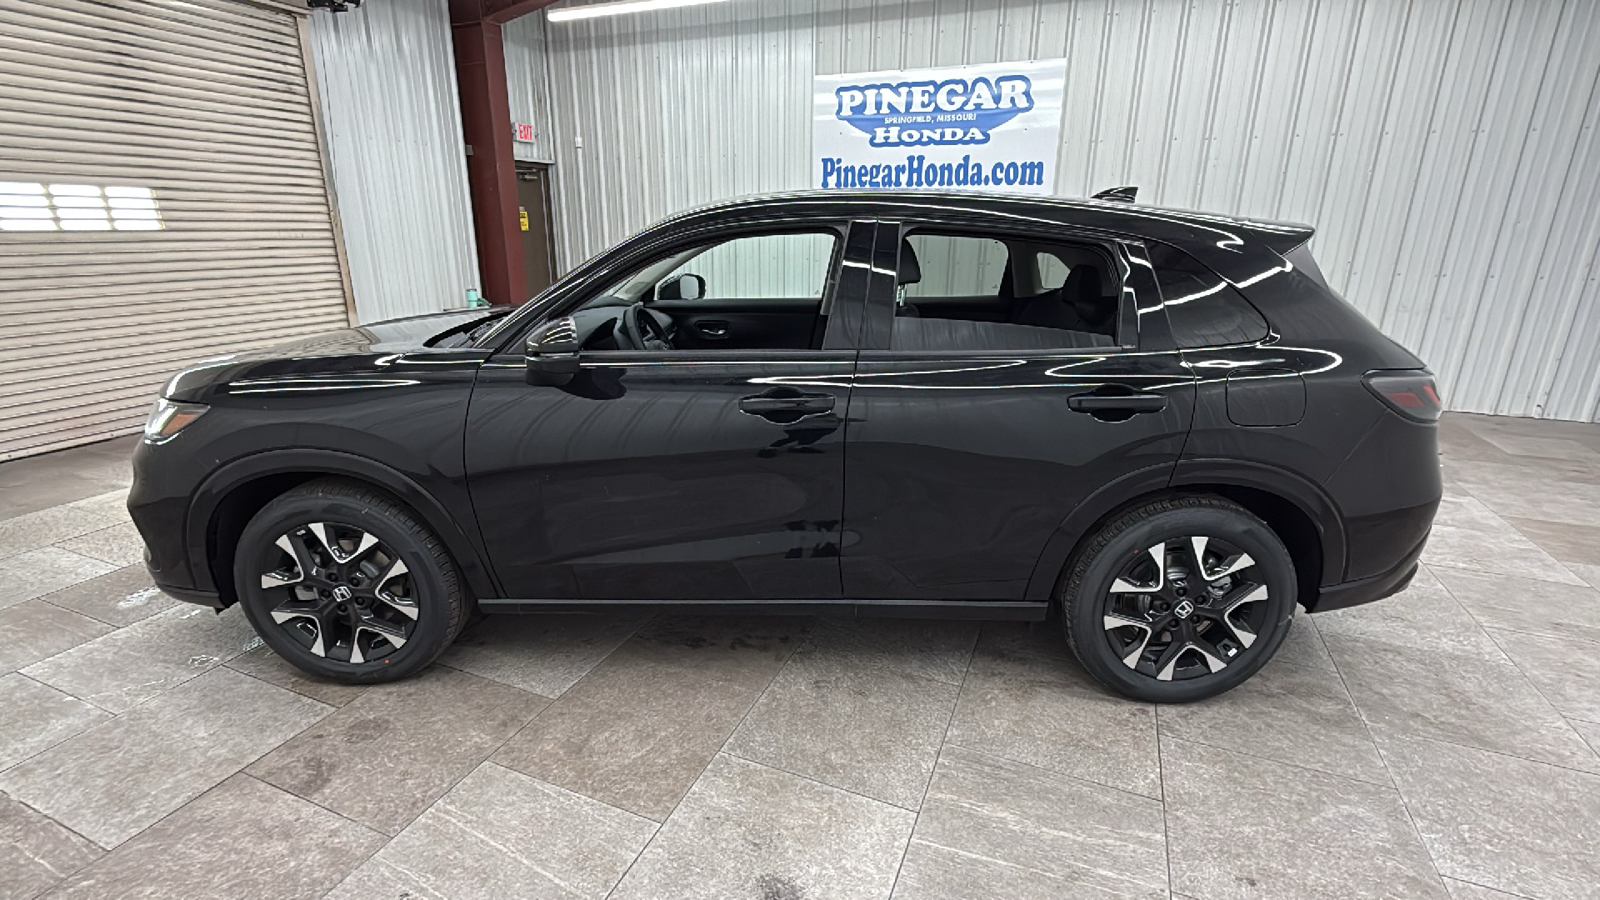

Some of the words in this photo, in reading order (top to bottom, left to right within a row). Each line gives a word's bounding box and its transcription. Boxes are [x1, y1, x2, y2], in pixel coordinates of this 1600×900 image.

[838, 79, 1030, 117] PINEGAR
[884, 115, 935, 125] SPRINGFIELD,
[936, 112, 977, 123] MISSOURI
[518, 122, 533, 140] EXIT
[872, 126, 986, 144] HONDA
[821, 154, 1044, 189] PinegarHonda.com
